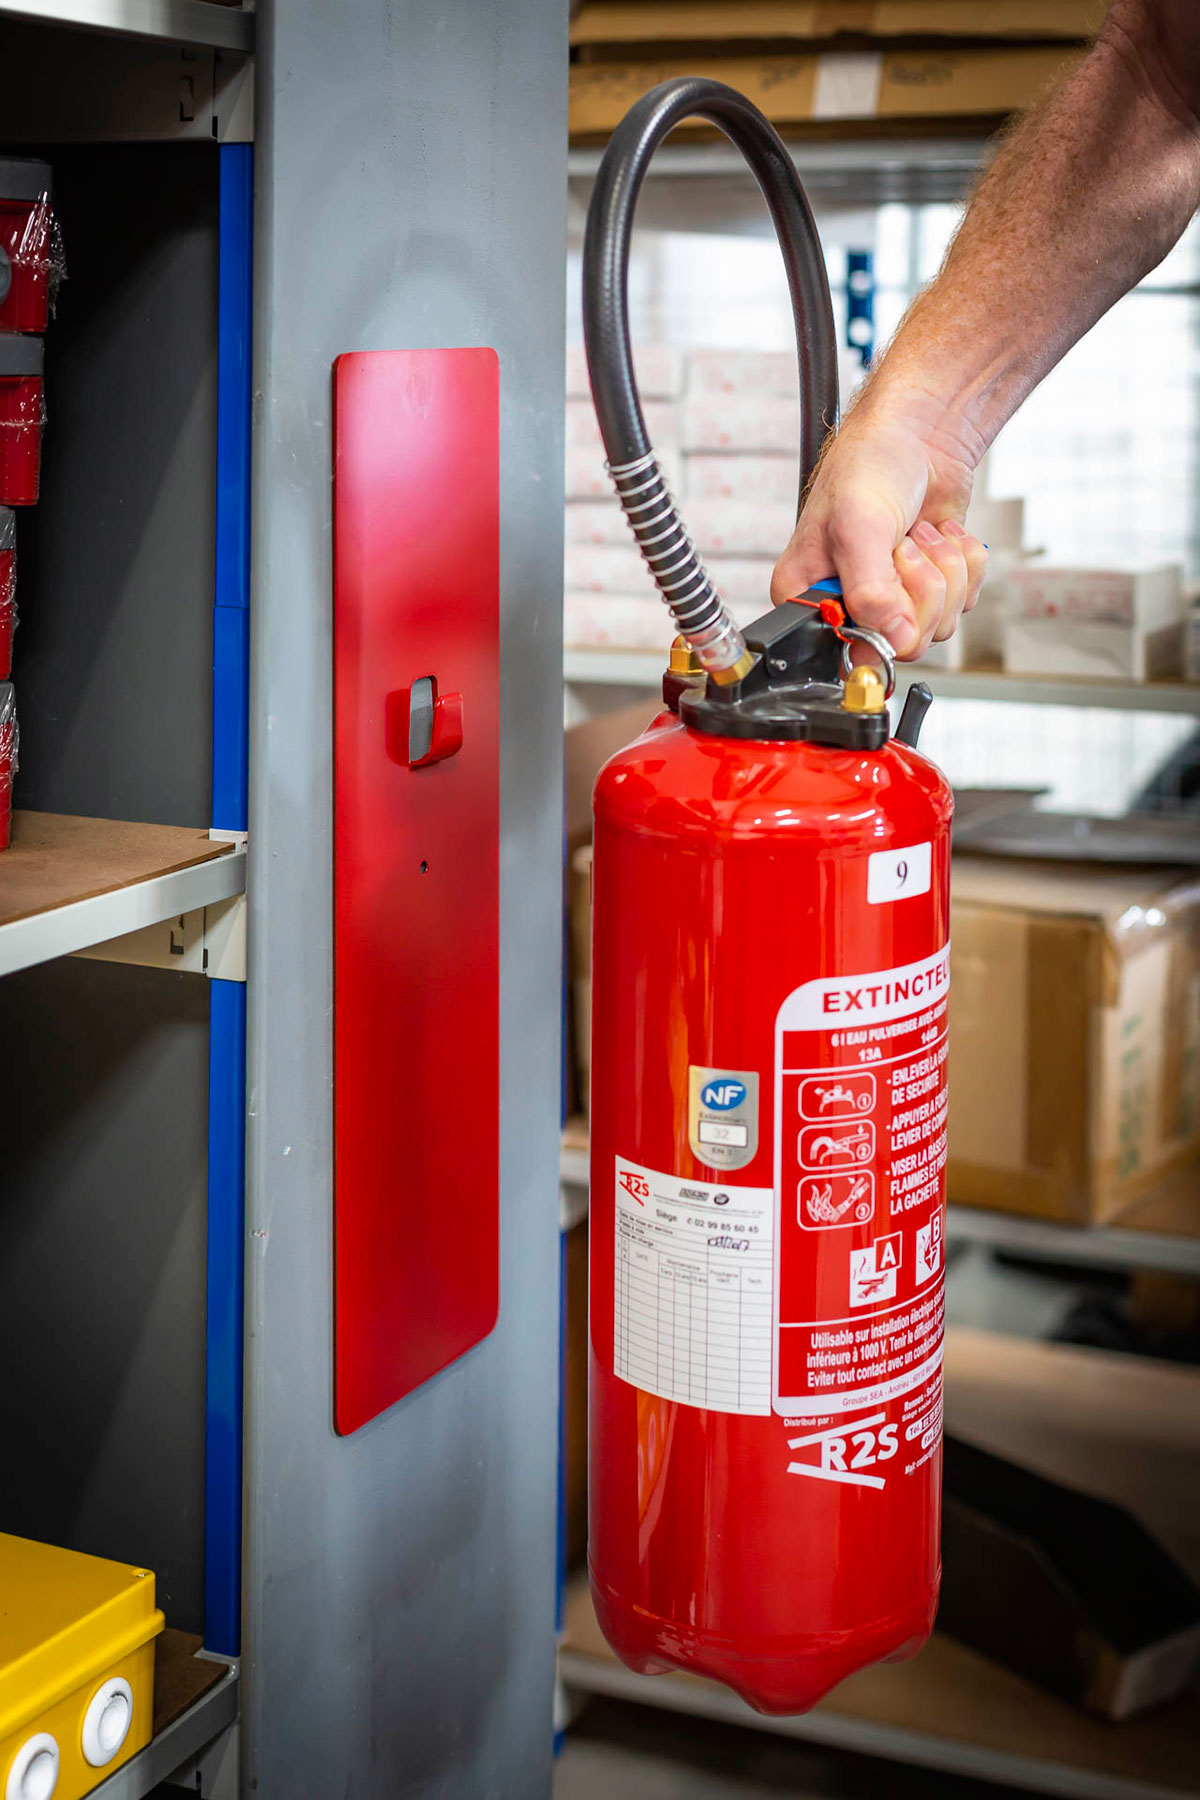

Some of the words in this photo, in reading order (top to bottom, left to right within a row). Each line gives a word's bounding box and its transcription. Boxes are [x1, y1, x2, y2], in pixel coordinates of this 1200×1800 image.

[896, 860, 908, 890] 9
[822, 956, 950, 1014] EXTINCTEU
[831, 1033, 839, 1047] 6
[846, 1030, 867, 1045] EAU
[858, 1046, 882, 1062] 13A
[930, 1053, 938, 1070] LA
[704, 1085, 743, 1106] NF
[891, 1087, 905, 1106] DE
[906, 1070, 939, 1101] SECURITE
[891, 1125, 921, 1151] LEVIER
[922, 1120, 931, 1139] DE
[917, 1148, 928, 1167] LA
[626, 1174, 649, 1197] R2S
[890, 1166, 929, 1197] FLAMMES
[929, 1160, 937, 1179] ET
[890, 1197, 903, 1216] LA
[904, 1176, 939, 1210] GACHETTE
[933, 1215, 940, 1242] B
[880, 1241, 897, 1269] A
[811, 1329, 853, 1349] Utilisable
[855, 1328, 870, 1343] sur
[871, 1315, 909, 1339] installation
[806, 1349, 851, 1368] inférieure
[852, 1346, 859, 1362] à
[860, 1341, 879, 1360] 1000
[890, 1332, 907, 1352] Tenir
[907, 1329, 913, 1344] le
[807, 1370, 835, 1388] Eviter
[837, 1367, 855, 1384] tout
[856, 1359, 886, 1380] contact
[887, 1354, 903, 1372] avec
[904, 1351, 912, 1364] un
[842, 1395, 868, 1407] Groupe
[870, 1388, 883, 1400] SEA
[783, 1417, 816, 1427] Distribué
[818, 1418, 829, 1427] par
[821, 1423, 899, 1471] R2S
